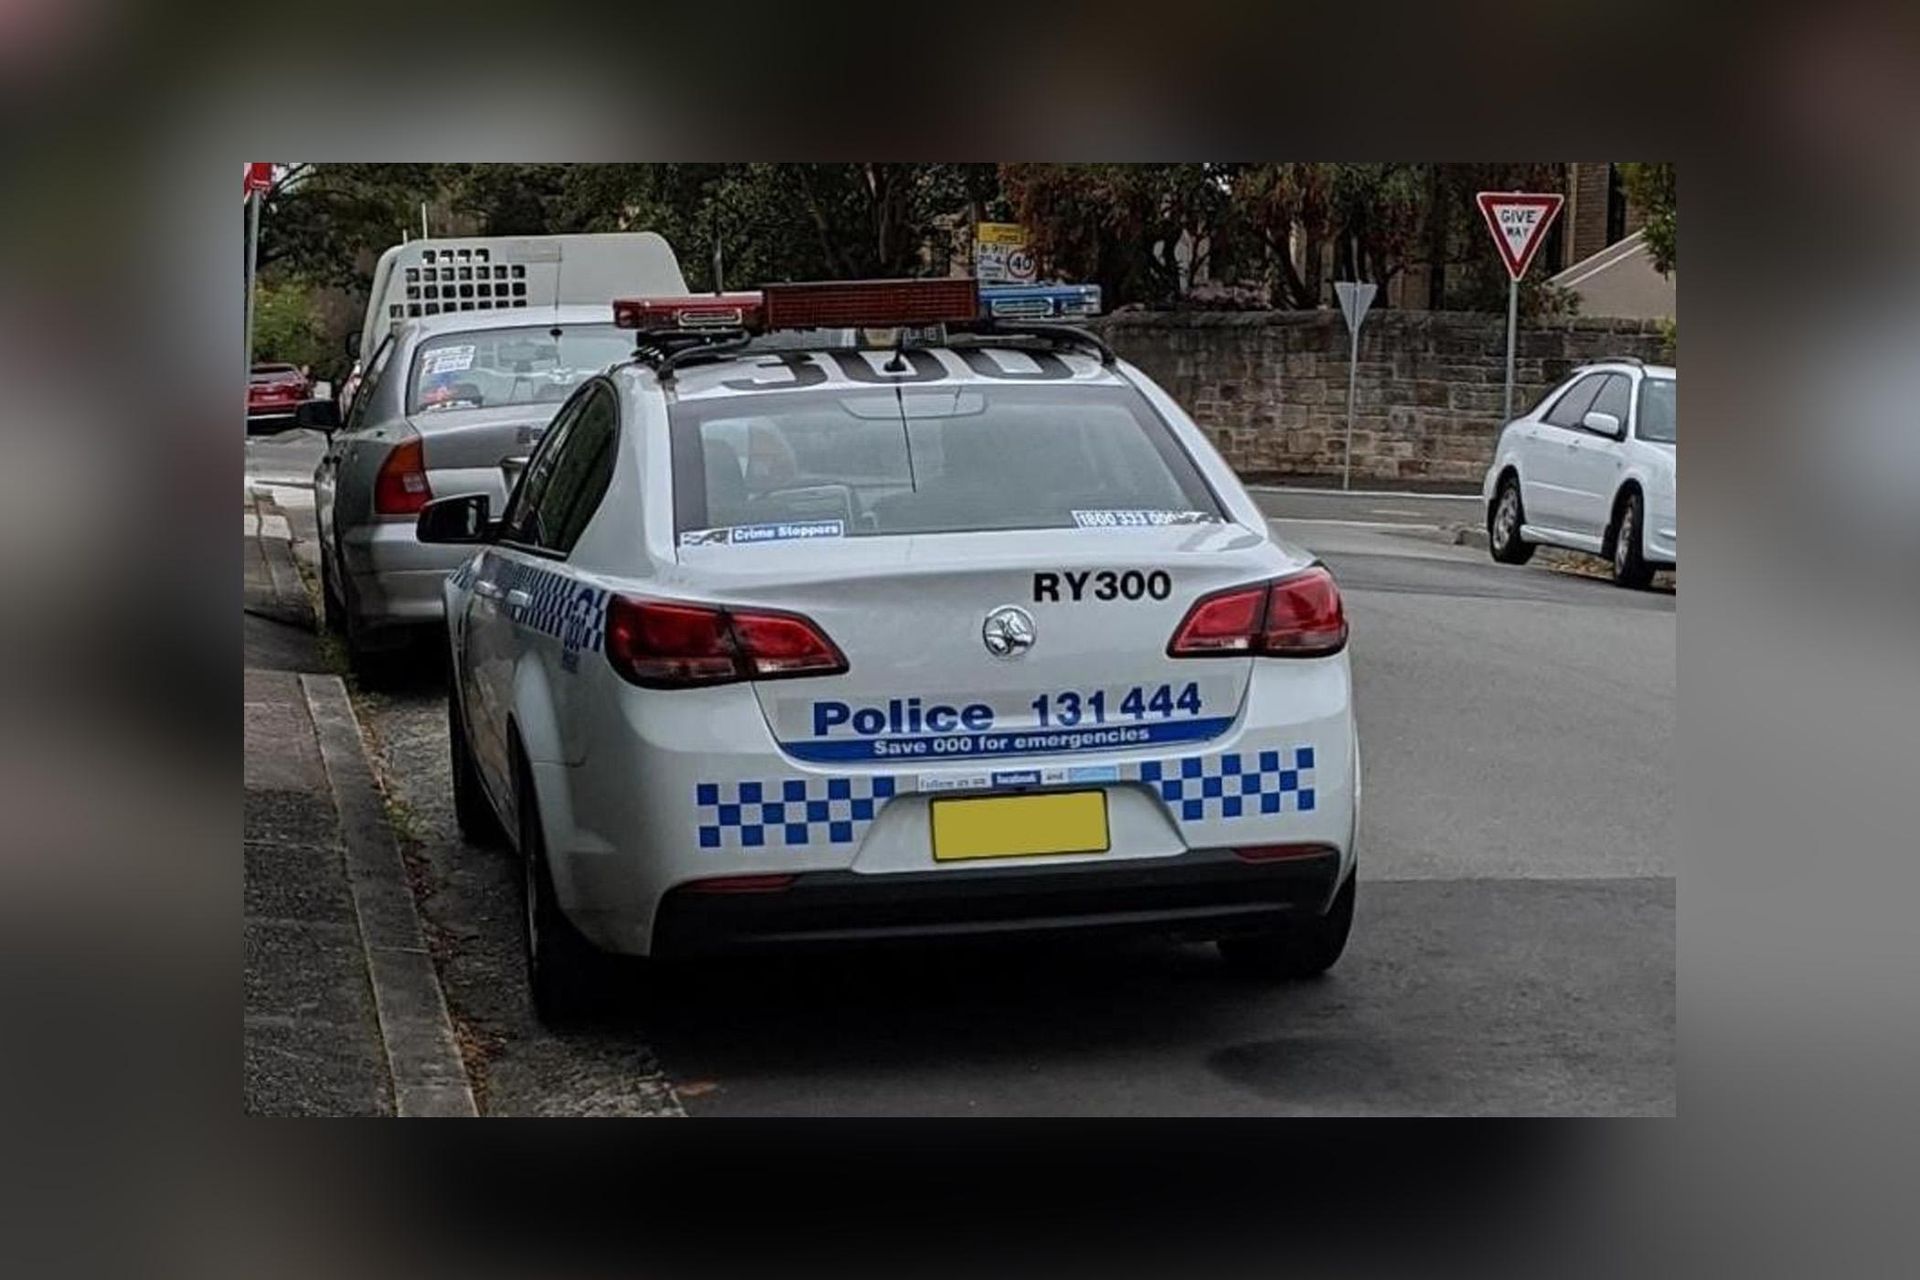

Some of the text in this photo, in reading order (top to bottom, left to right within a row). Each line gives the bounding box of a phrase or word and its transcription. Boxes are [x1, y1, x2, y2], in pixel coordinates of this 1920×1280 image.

[1502, 209, 1536, 223] GIVE
[1506, 227, 1529, 238] WAY
[1011, 255, 1032, 270] 40
[1079, 511, 1116, 526] 1800
[734, 523, 839, 541] Crime Stoppers
[1033, 570, 1172, 602] RY300
[813, 682, 1202, 736] Police 131 444
[874, 727, 1150, 755] Save 000 for emergencies
